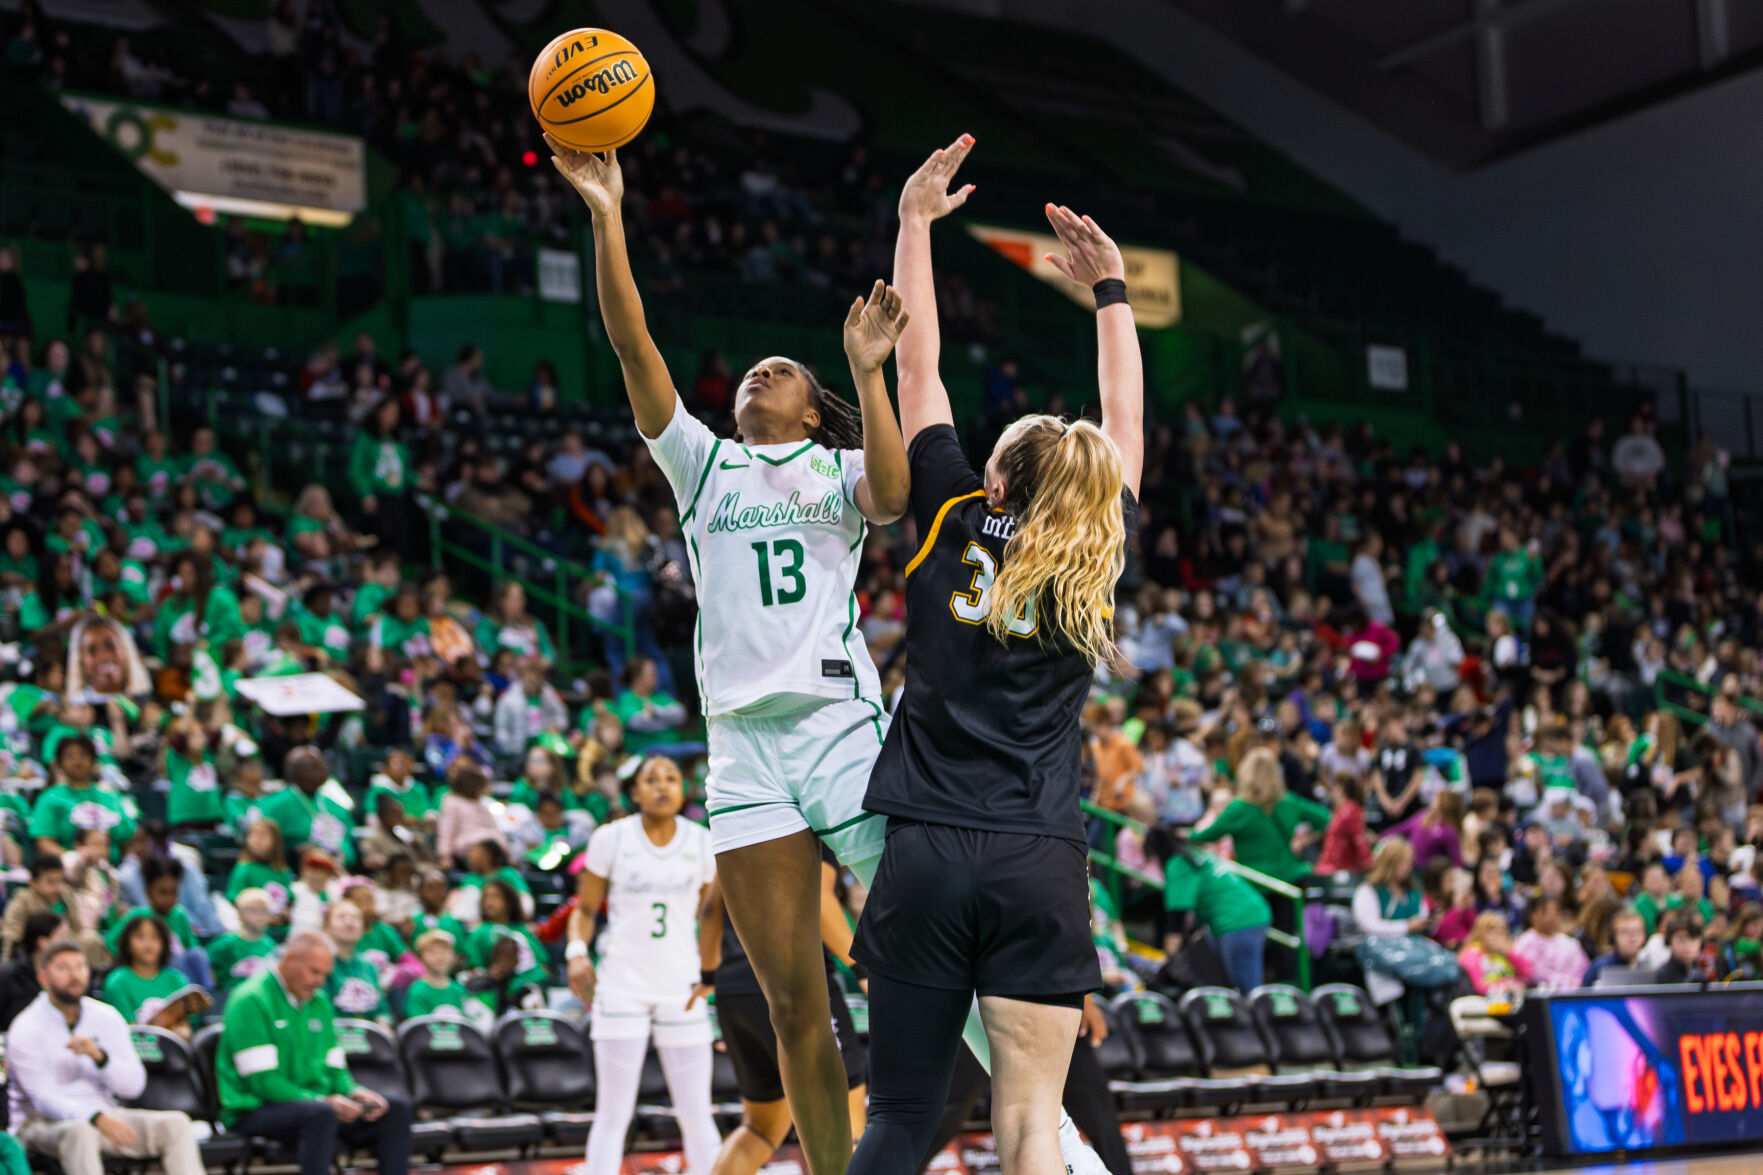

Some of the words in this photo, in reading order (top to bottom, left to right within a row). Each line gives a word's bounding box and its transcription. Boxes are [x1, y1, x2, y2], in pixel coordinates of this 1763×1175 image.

[555, 36, 598, 68] EVO
[556, 59, 638, 108] Wilson
[707, 490, 842, 533] Marshall
[751, 538, 807, 607] 13
[652, 902, 667, 939] 3
[1679, 1031, 1748, 1113] EYES
